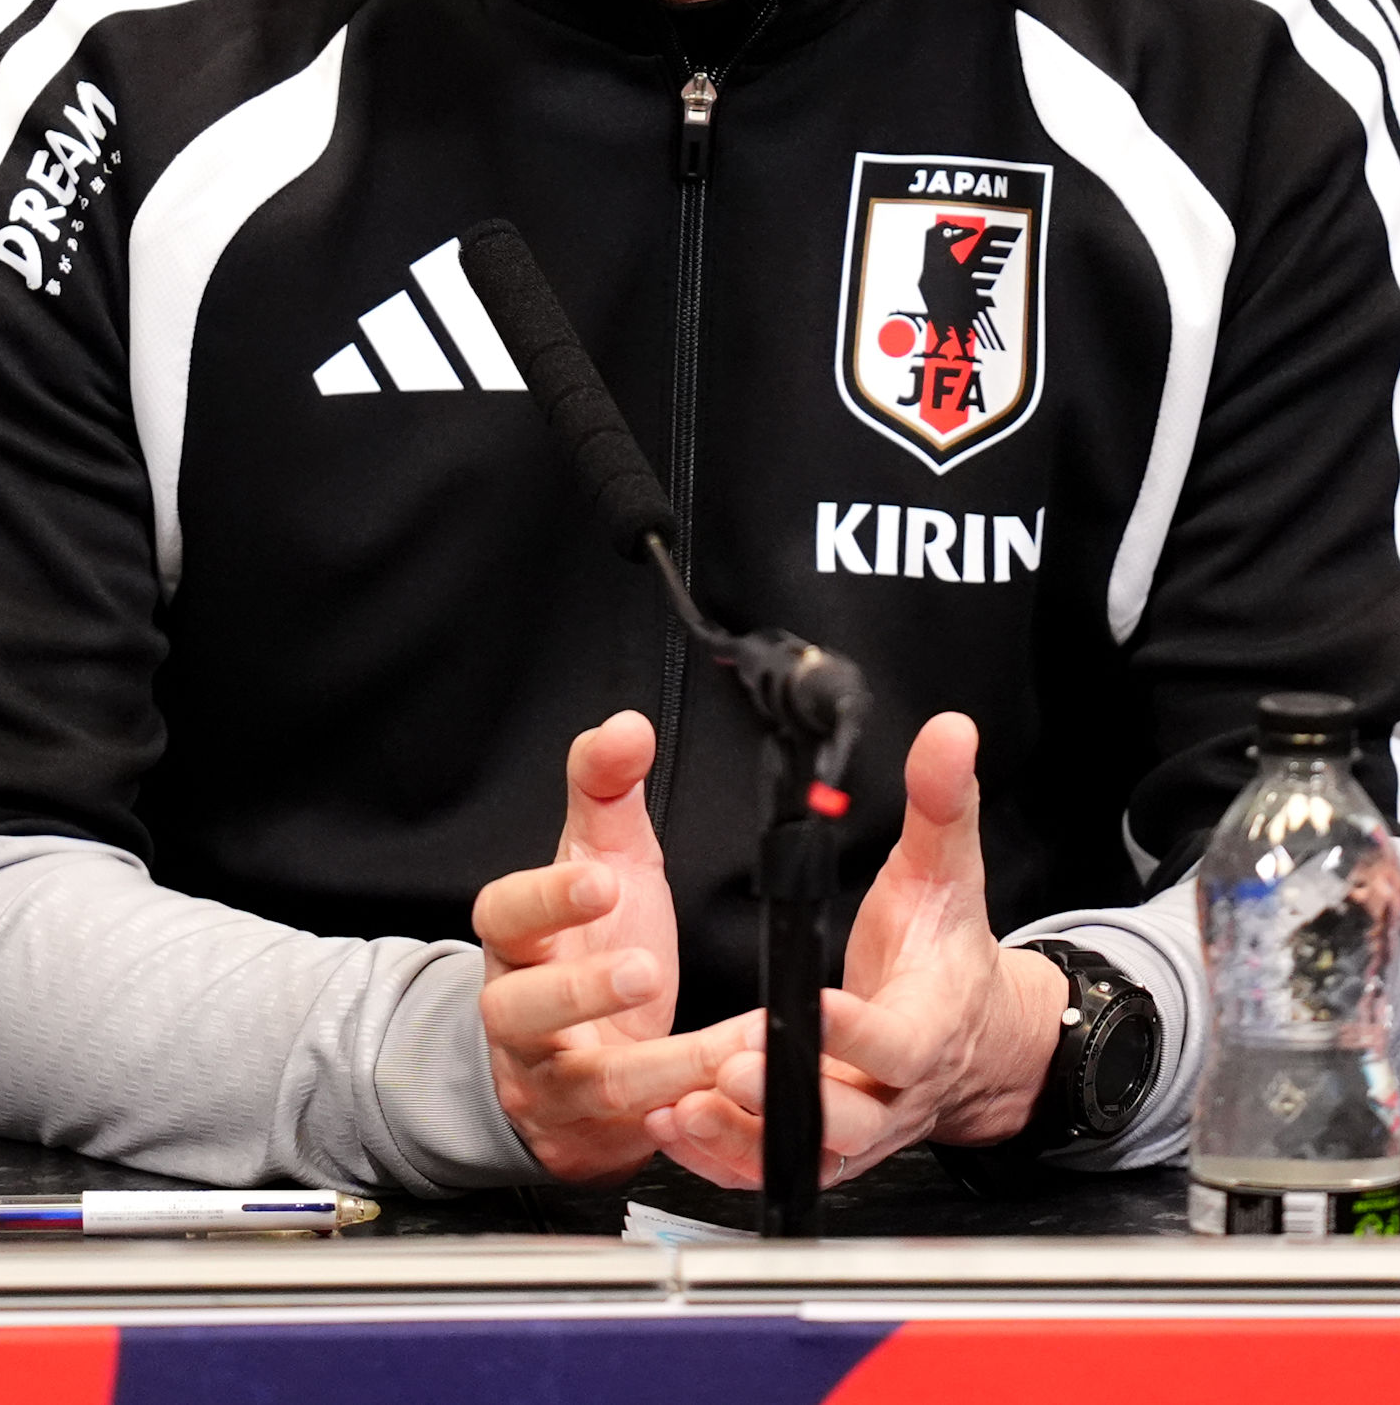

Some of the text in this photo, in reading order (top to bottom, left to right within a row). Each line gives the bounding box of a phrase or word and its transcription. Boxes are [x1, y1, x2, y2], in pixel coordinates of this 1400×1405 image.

[908, 168, 1009, 199] JAPAN
[896, 365, 987, 413] JFA
[815, 502, 1046, 584] KIRIN
